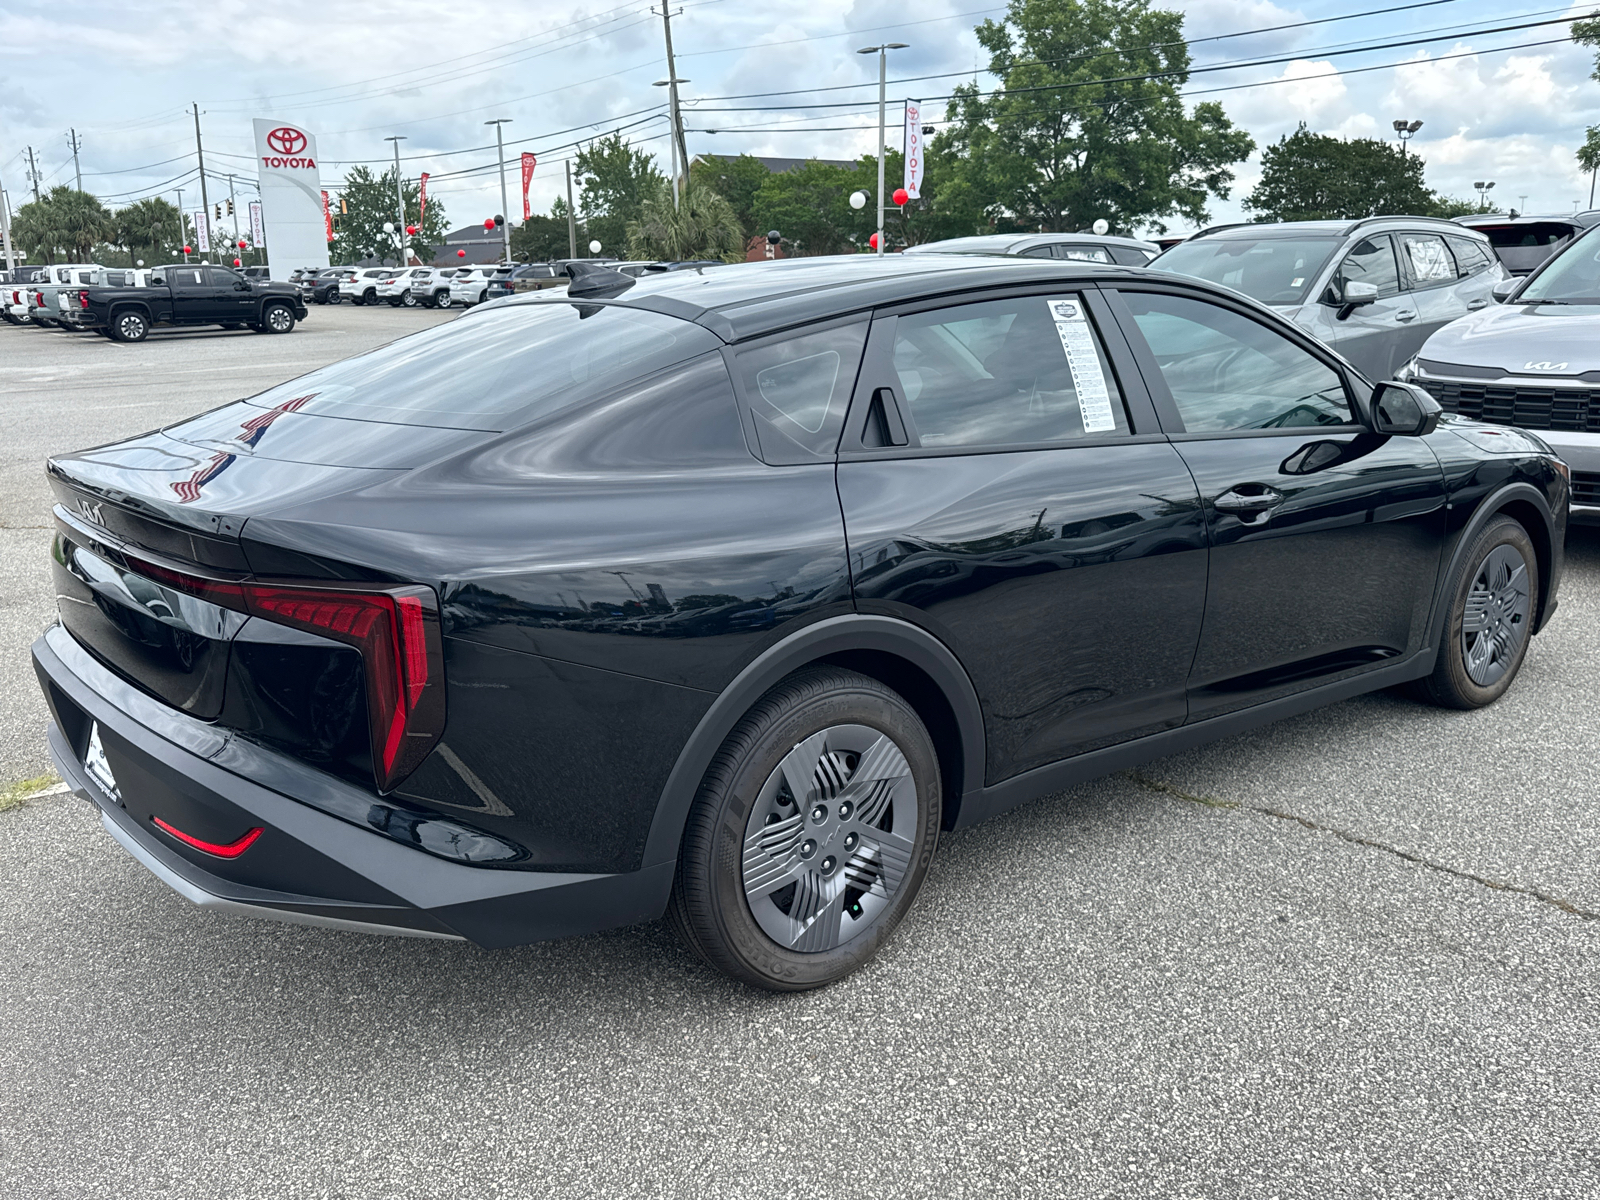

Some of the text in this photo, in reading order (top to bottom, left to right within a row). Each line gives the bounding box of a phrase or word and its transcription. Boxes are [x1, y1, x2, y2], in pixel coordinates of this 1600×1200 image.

[261, 157, 316, 169] TOYOTA
[909, 123, 917, 191] TOYOTA
[1523, 361, 1568, 371] KIA
[76, 498, 104, 527] KIA
[922, 781, 938, 869] KUMHO
[740, 933, 798, 978] SOLUS
